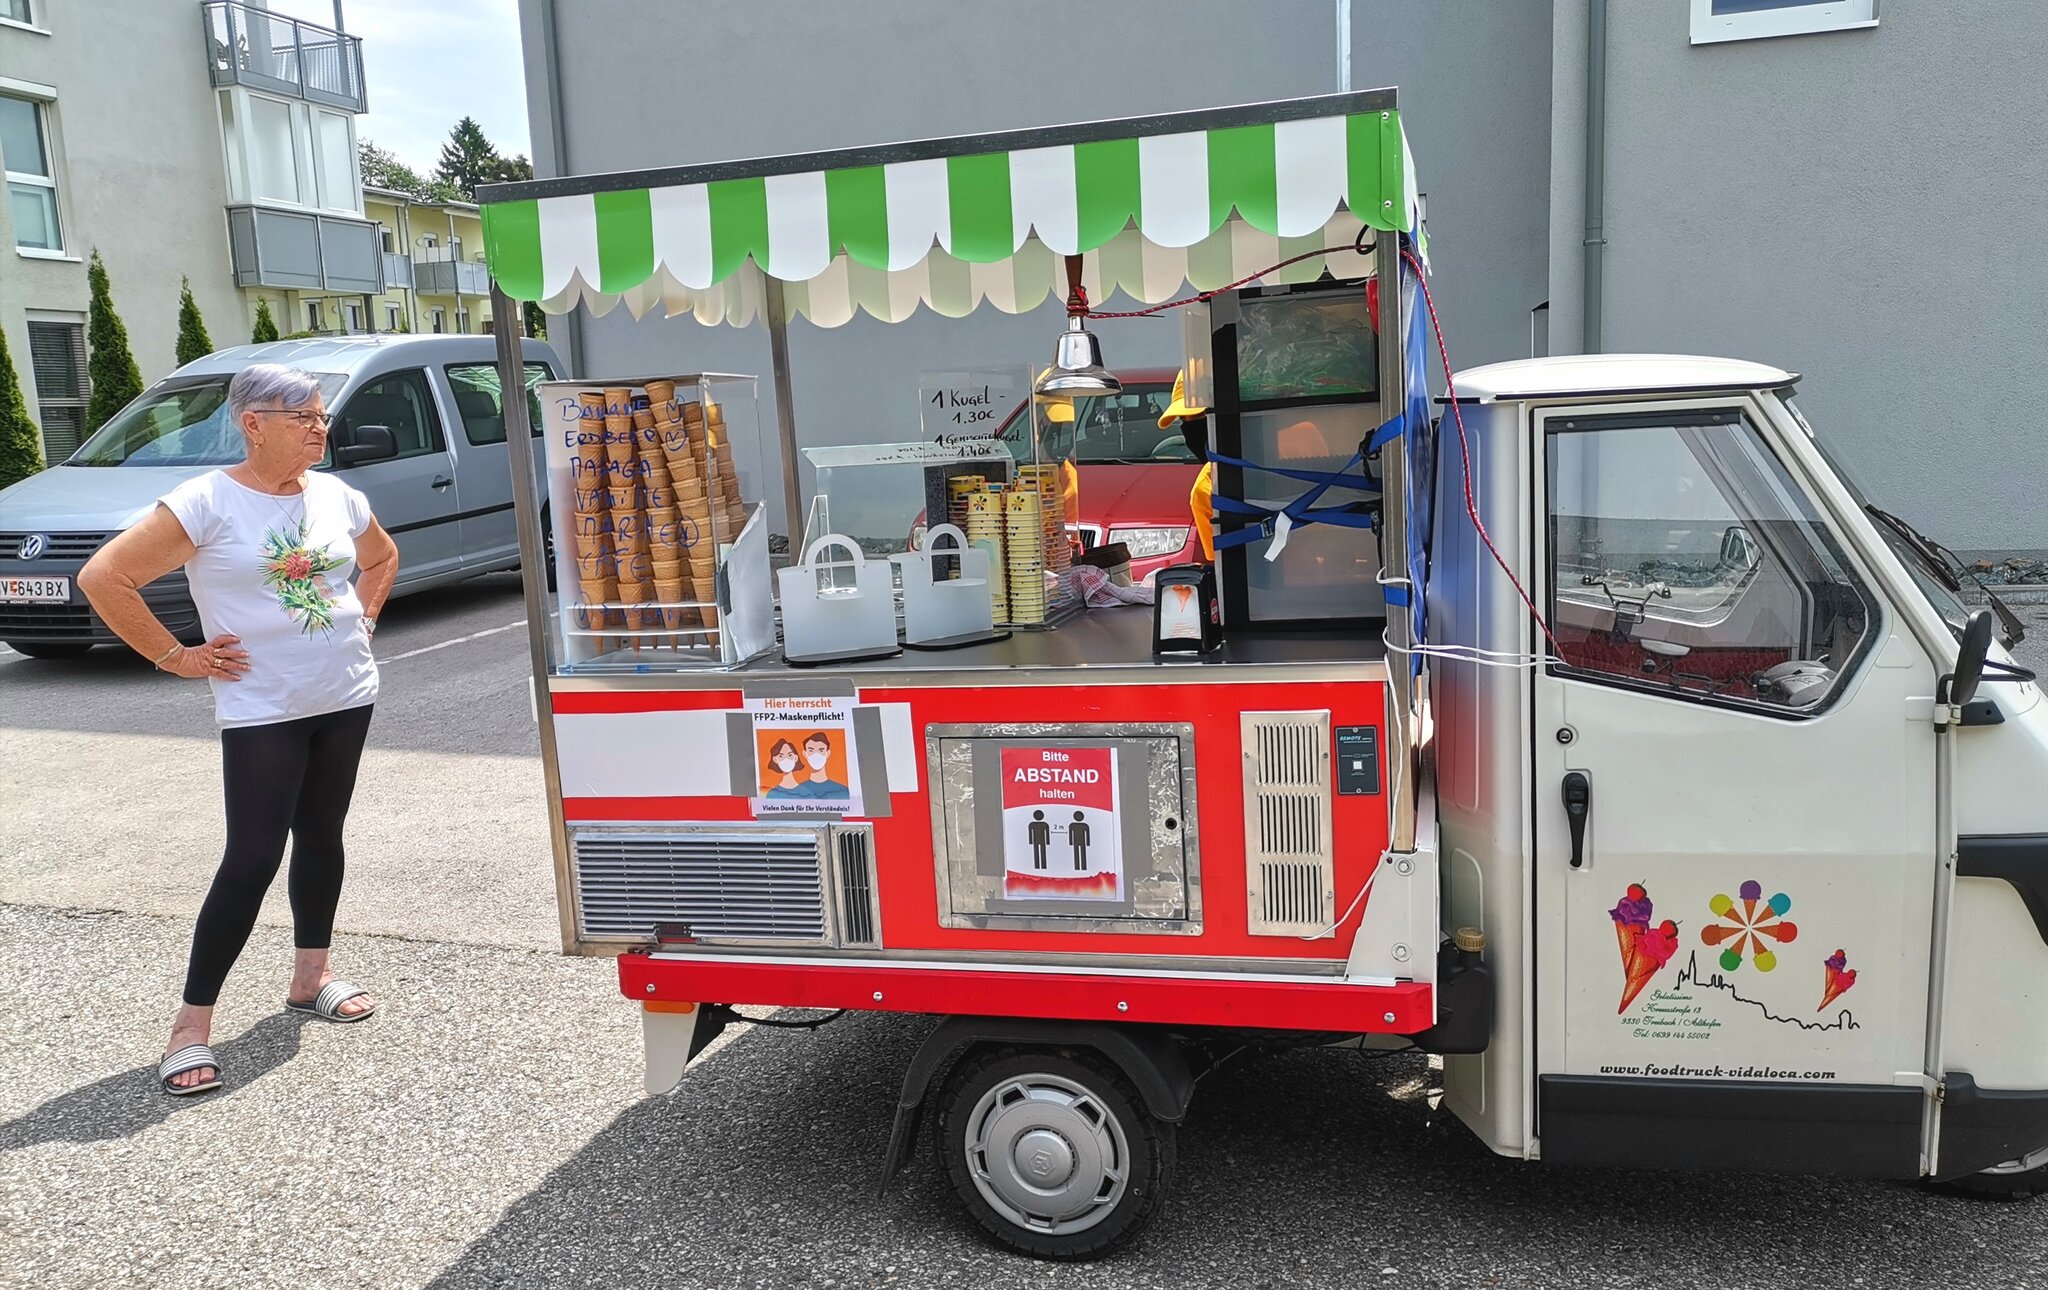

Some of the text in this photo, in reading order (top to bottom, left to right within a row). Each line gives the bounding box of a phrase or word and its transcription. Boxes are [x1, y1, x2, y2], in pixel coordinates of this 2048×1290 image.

[932, 390, 943, 409] 1
[951, 385, 991, 407] KUGEL
[18, 581, 42, 596] 643
[46, 581, 63, 597] BX
[765, 698, 832, 708] Hier herrscht
[754, 712, 845, 722] FFP2-Maskenpflicht!
[1042, 751, 1069, 761] Bitte
[1014, 768, 1099, 783] ABSTAND
[1040, 788, 1075, 799] halten
[805, 804, 815, 812] Ihr
[816, 804, 850, 812] Verständnis!
[1600, 1064, 1836, 1080] www.foodtruck-vidaloca.com
